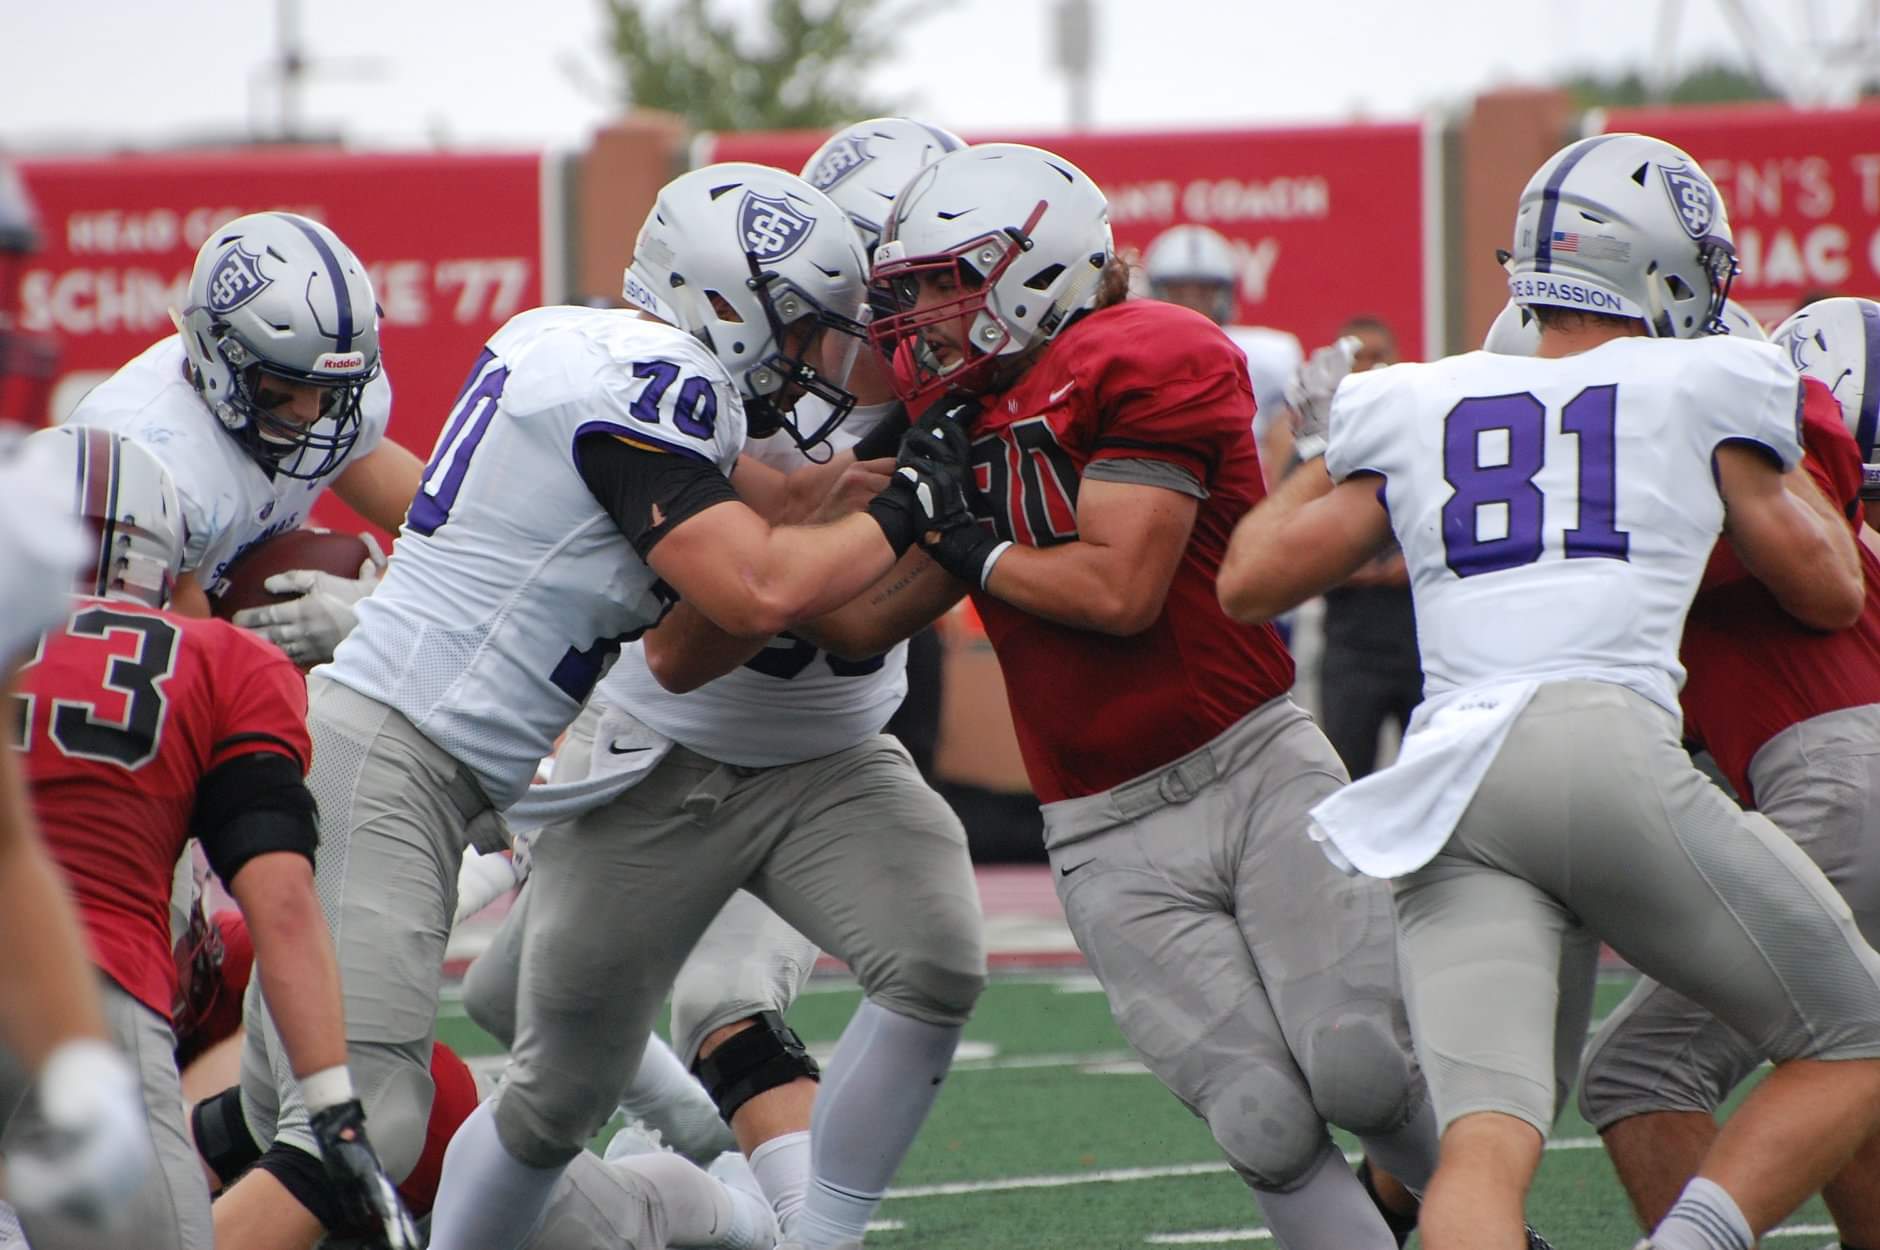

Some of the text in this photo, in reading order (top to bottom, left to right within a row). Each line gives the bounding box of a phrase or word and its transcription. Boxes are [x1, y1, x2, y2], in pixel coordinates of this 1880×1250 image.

[1182, 178, 1329, 222] COACH
[1702, 155, 1835, 219] EN'S
[67, 208, 178, 252] HEAD
[1738, 225, 1851, 289] IAC
[434, 256, 530, 326] '77
[1536, 280, 1622, 312] PASSION
[629, 360, 718, 441] 70
[1443, 382, 1631, 579] 81
